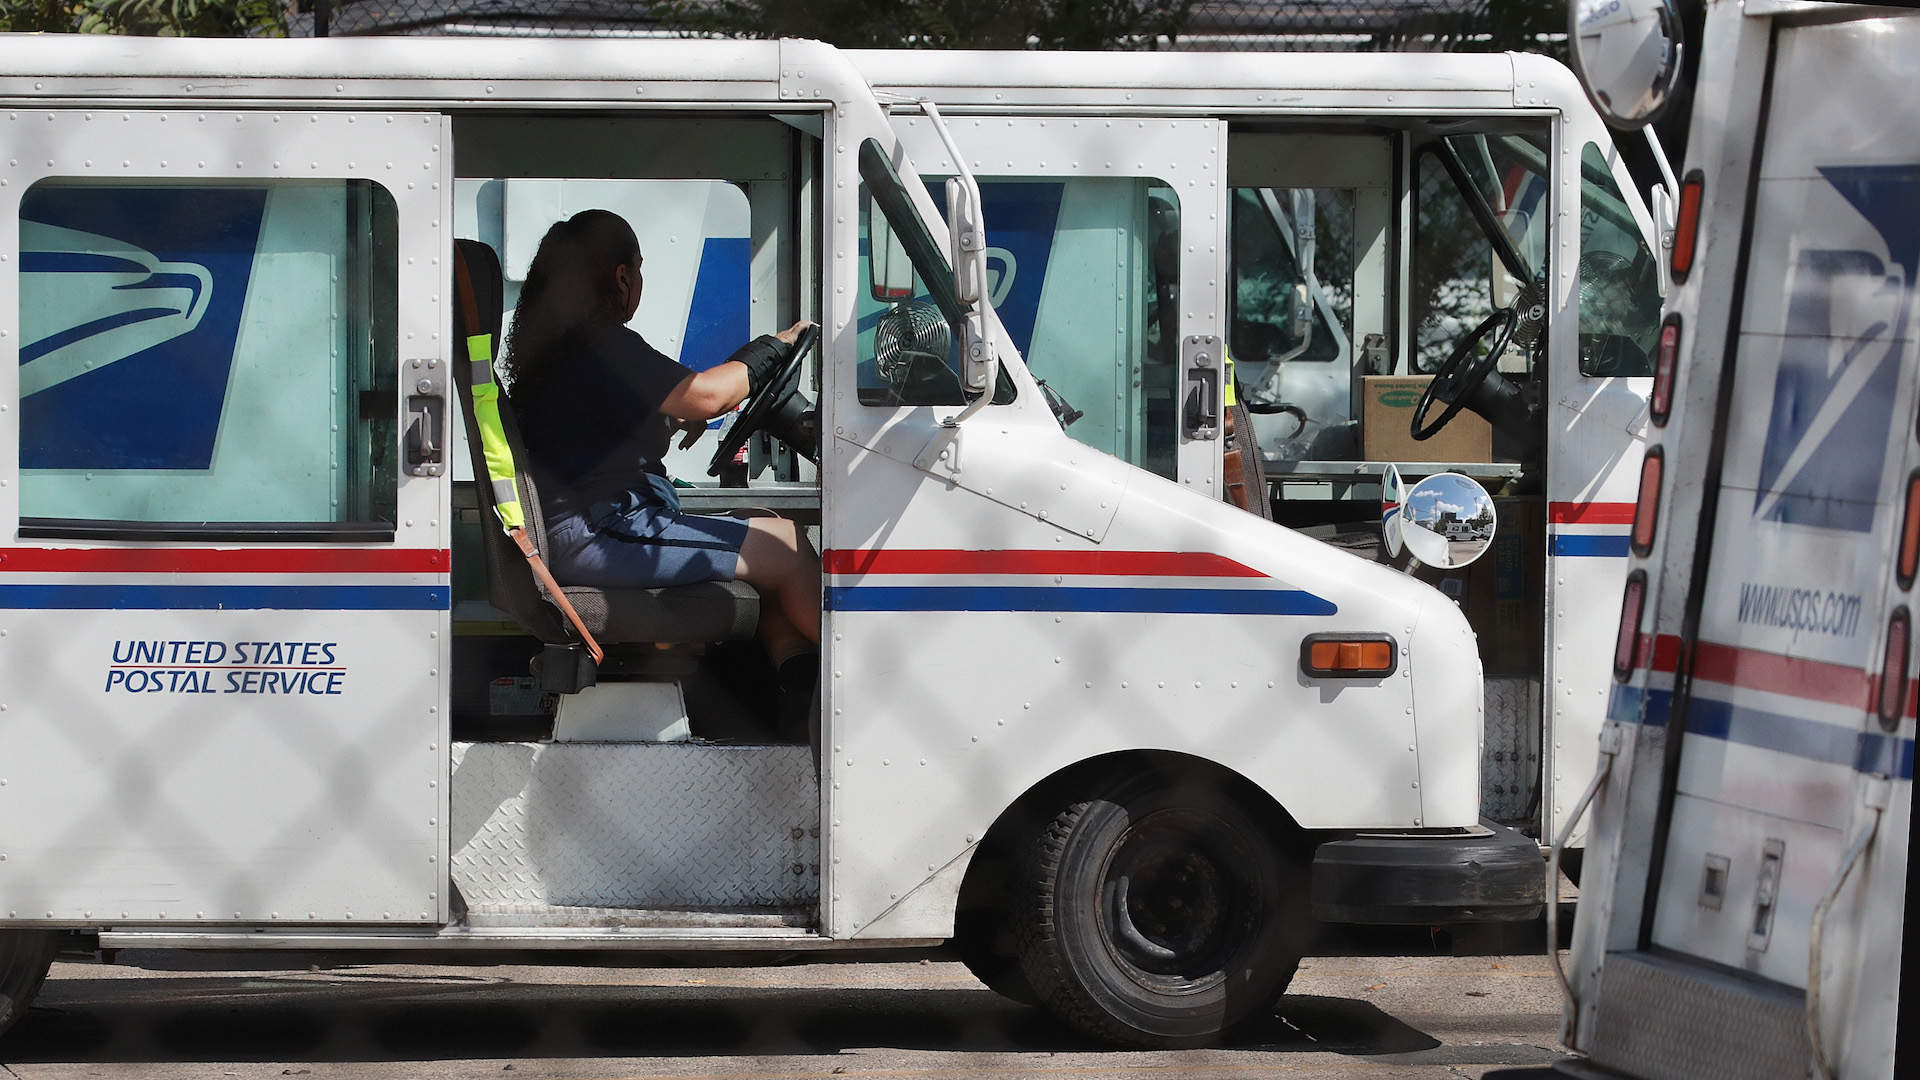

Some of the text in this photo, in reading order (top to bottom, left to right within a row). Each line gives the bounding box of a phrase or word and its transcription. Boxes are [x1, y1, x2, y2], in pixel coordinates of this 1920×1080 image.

[1738, 582, 1862, 644] www.usps.com
[112, 640, 337, 665] UNITED STATES
[105, 670, 347, 694] POSTAL SERVICE
